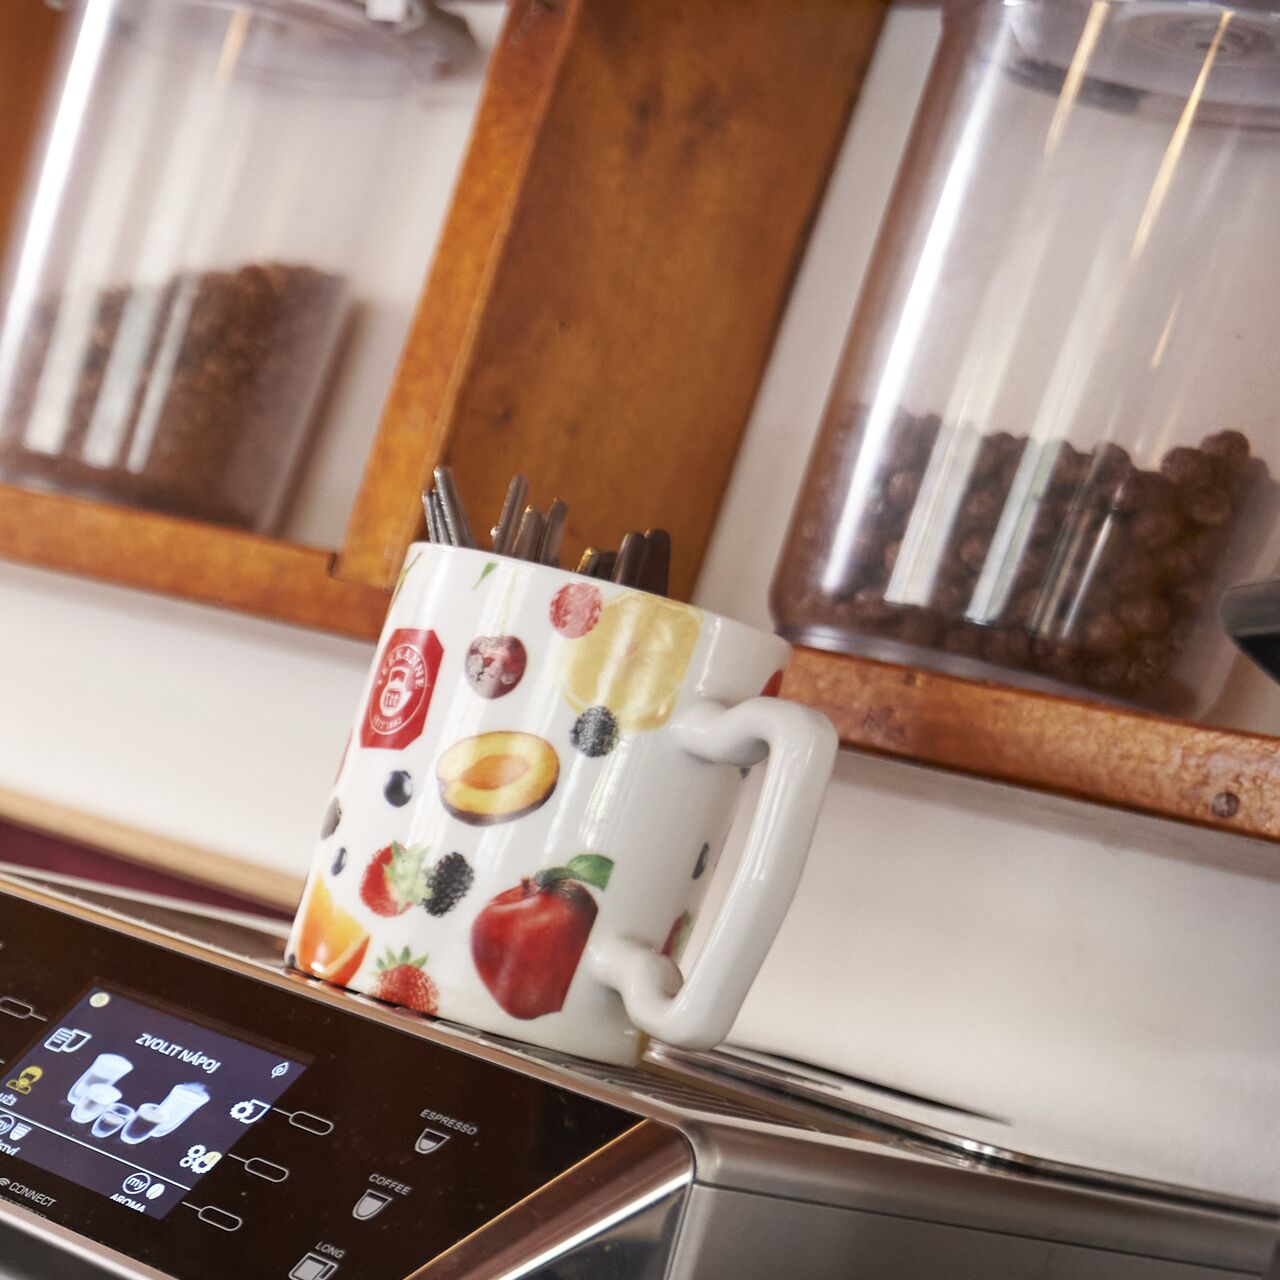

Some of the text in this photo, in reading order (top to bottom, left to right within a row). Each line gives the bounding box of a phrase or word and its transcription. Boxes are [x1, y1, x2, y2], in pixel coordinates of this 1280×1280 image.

[135, 1033, 222, 1074] ZVOLIT NÁPOJ
[419, 1108, 478, 1136] ESPRESSO
[8, 1182, 57, 1207] CONNECT
[368, 1173, 412, 1197] COFFEE
[109, 1193, 146, 1213] AROMA
[315, 1241, 345, 1259] LONG
